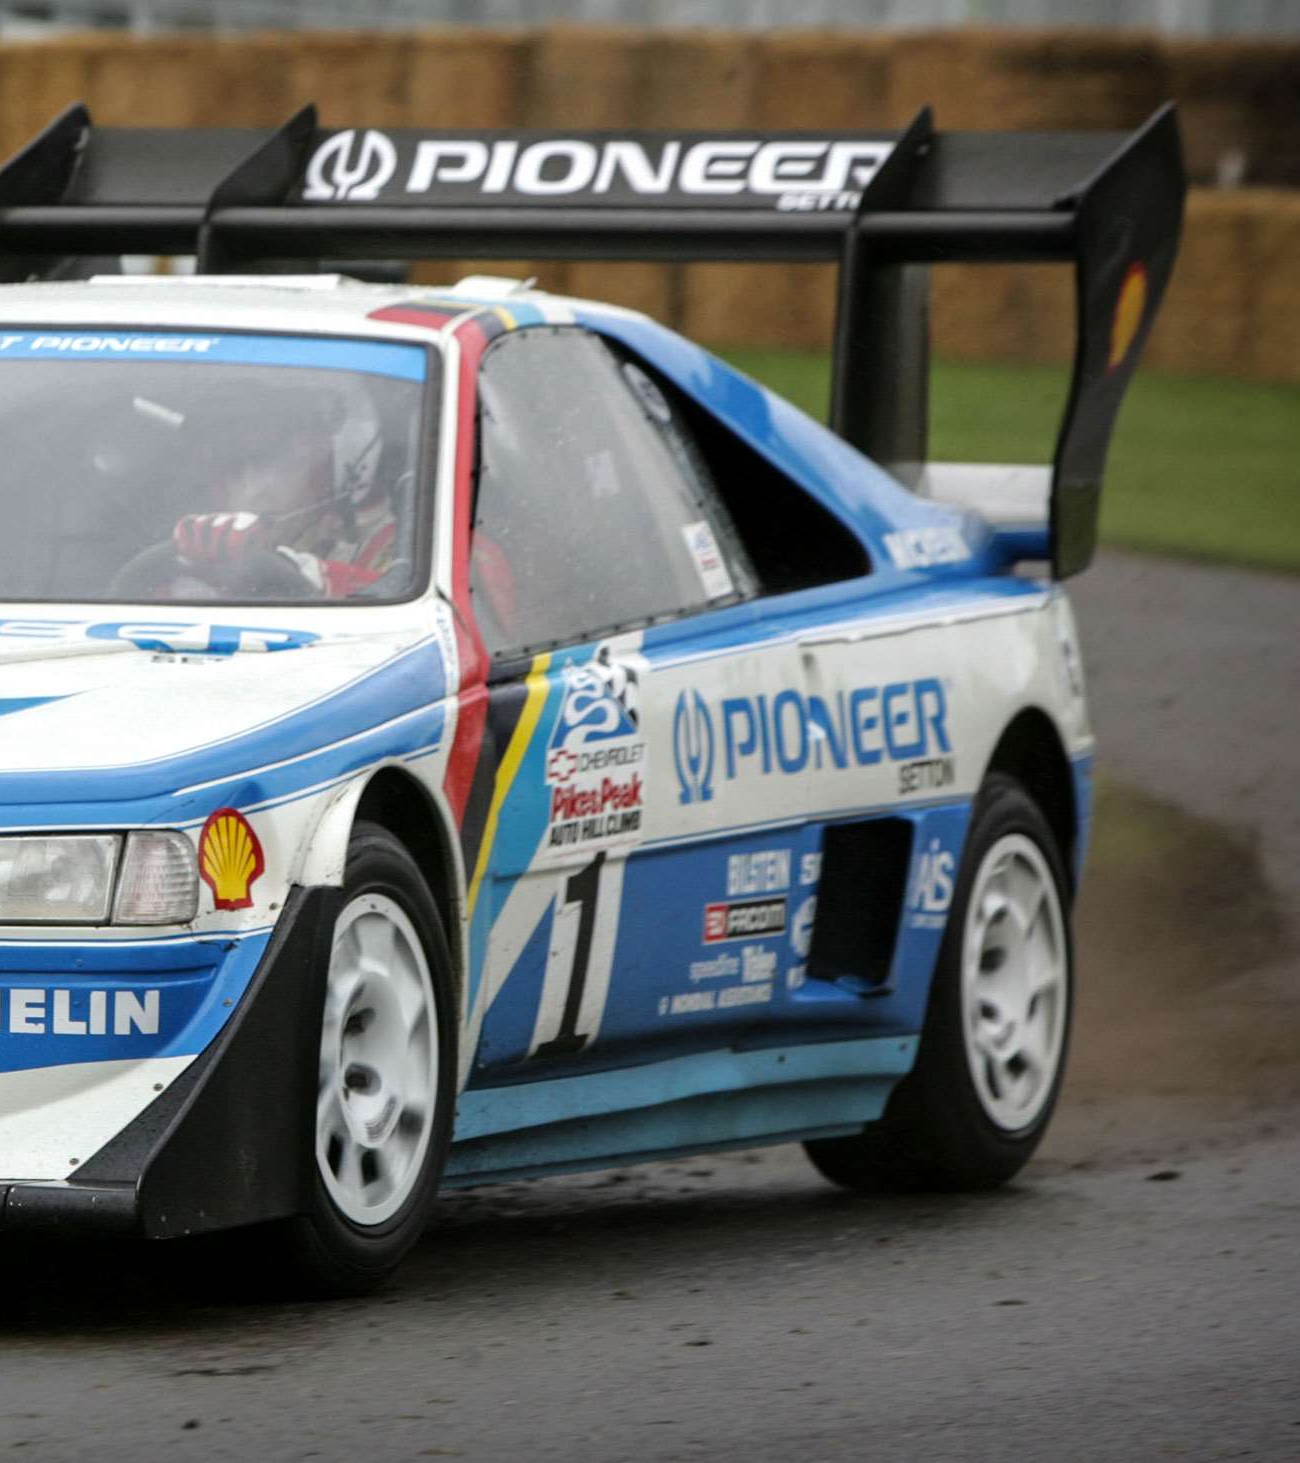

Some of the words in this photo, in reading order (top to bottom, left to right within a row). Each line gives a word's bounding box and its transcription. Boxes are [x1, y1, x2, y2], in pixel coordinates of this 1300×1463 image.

[405, 139, 898, 195] PIONEER
[30, 335, 212, 352] PIONEER
[721, 677, 952, 780] PIONEER
[578, 742, 645, 773] CHEVROLET
[899, 756, 957, 796] SETTON
[600, 771, 644, 813] Peak
[549, 821, 579, 847] AUTO
[579, 817, 604, 842] HILL
[605, 808, 642, 837] CLIMB
[525, 850, 607, 1064] 1
